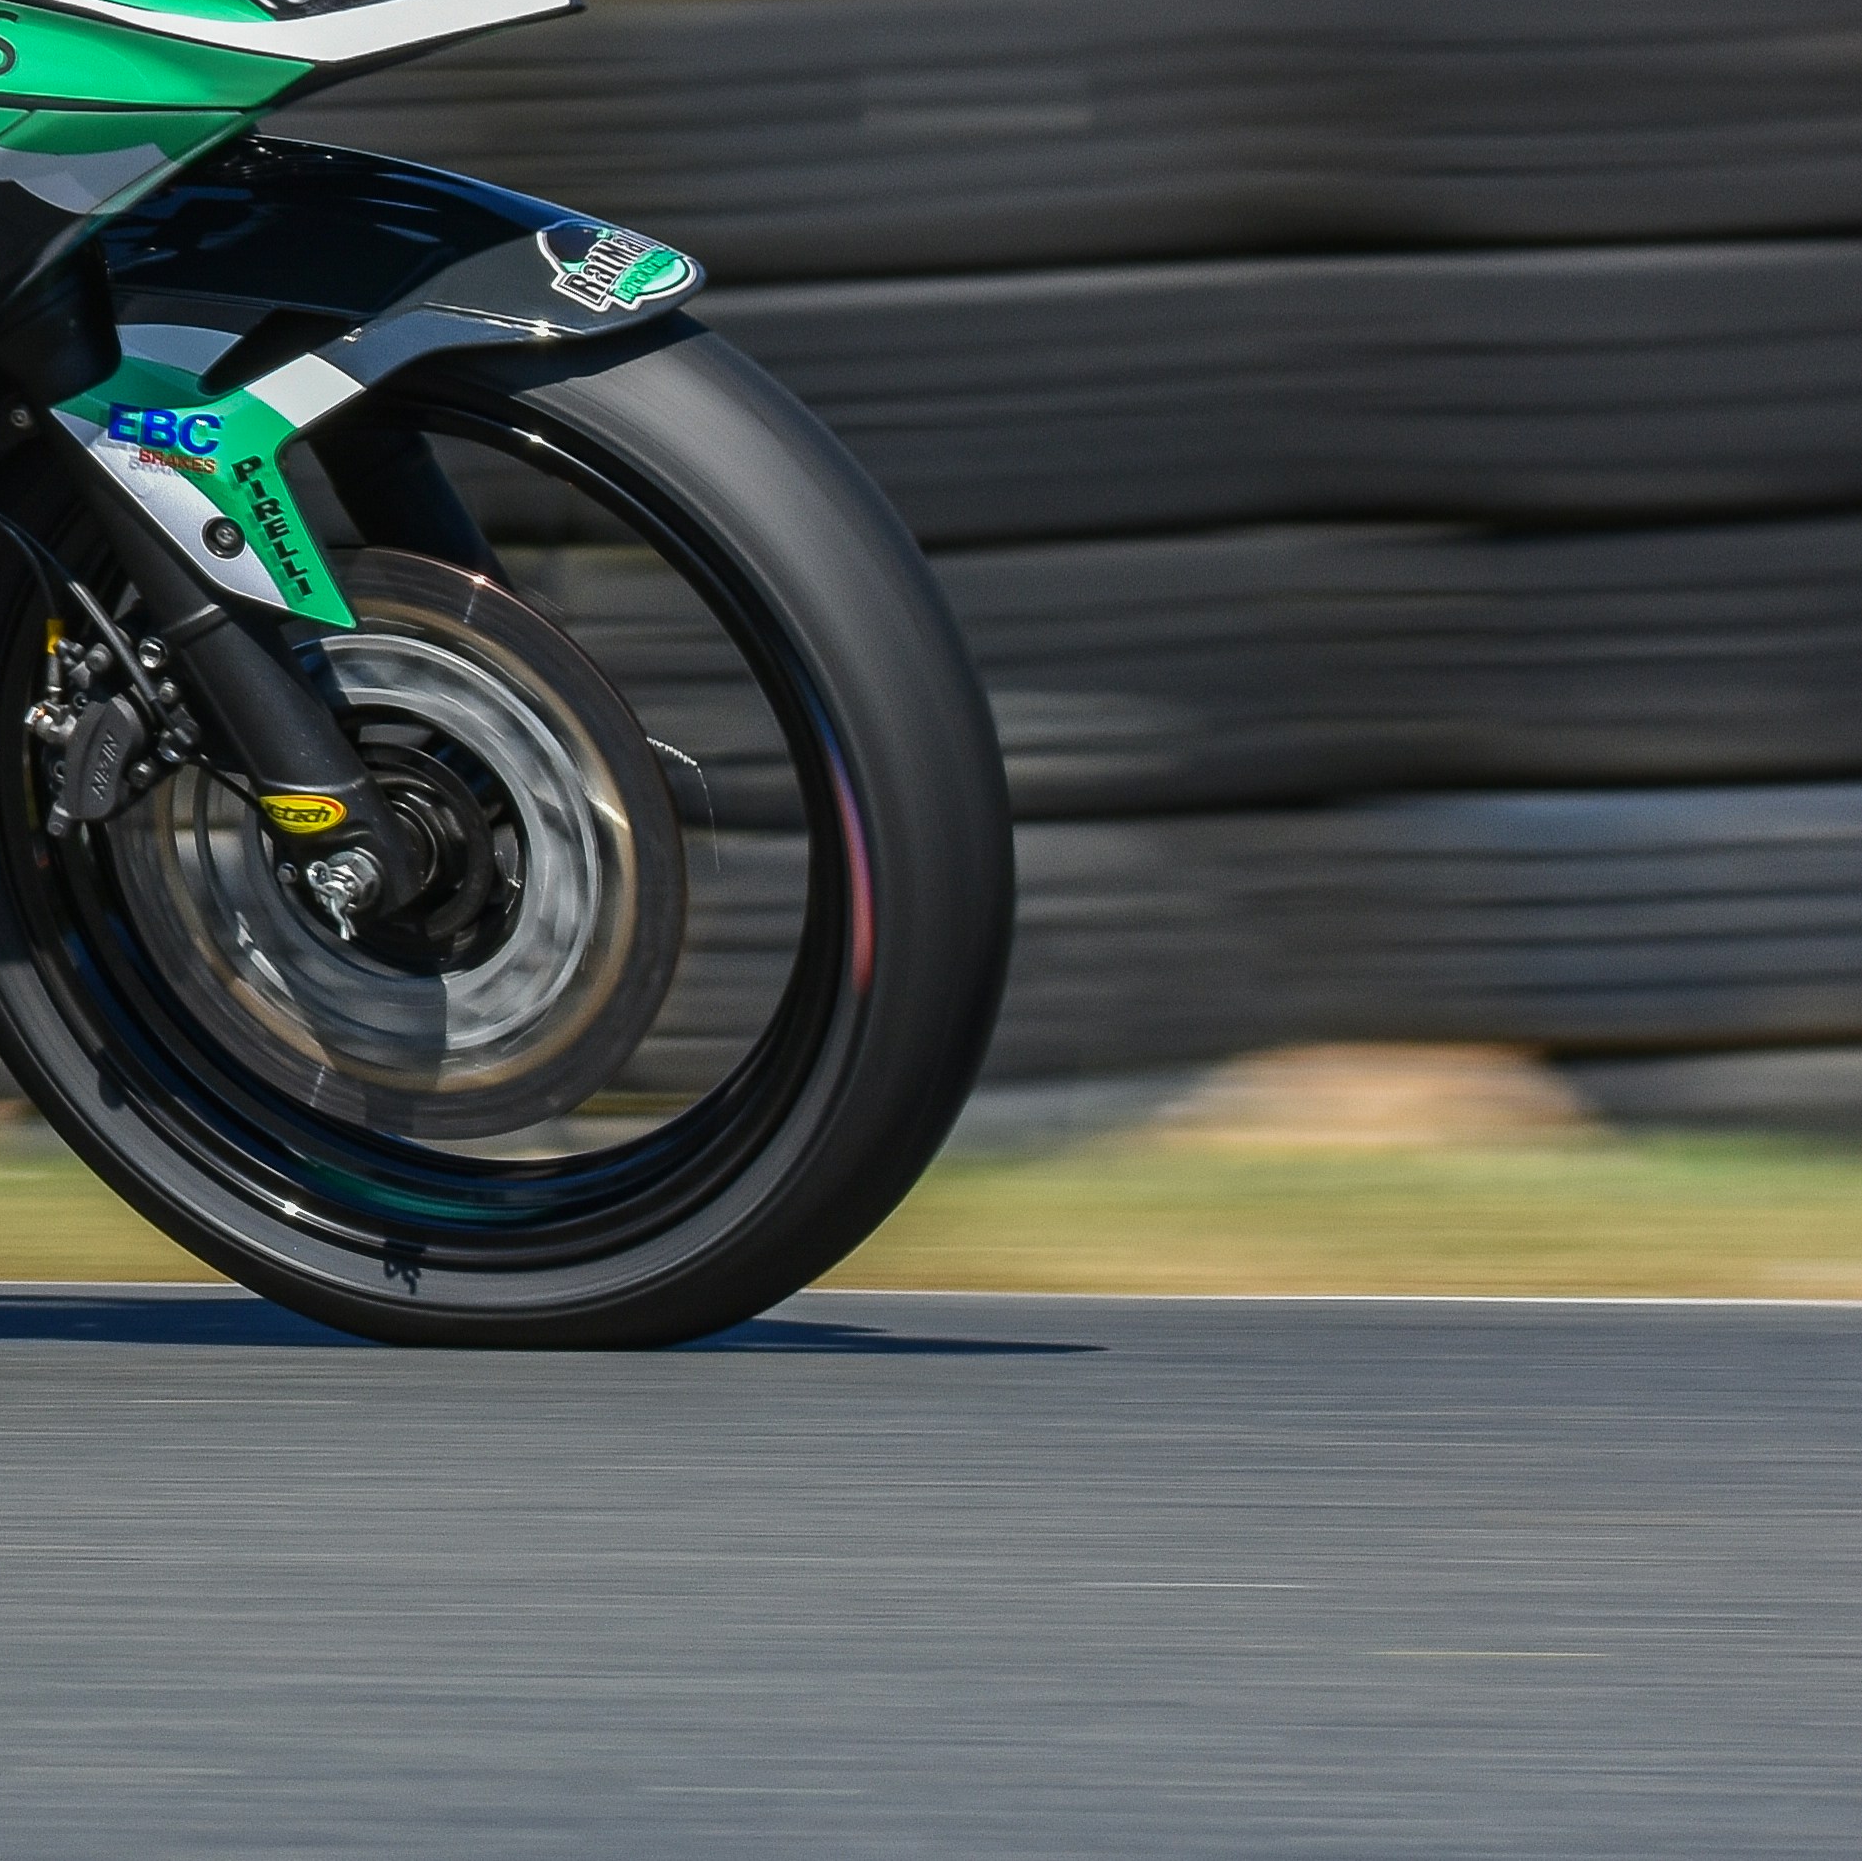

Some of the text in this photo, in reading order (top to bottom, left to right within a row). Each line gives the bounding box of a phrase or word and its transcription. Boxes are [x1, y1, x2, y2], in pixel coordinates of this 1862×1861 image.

[107, 401, 222, 455] EBC
[138, 448, 217, 474] BRAKES
[231, 455, 314, 597] PIRELLI
